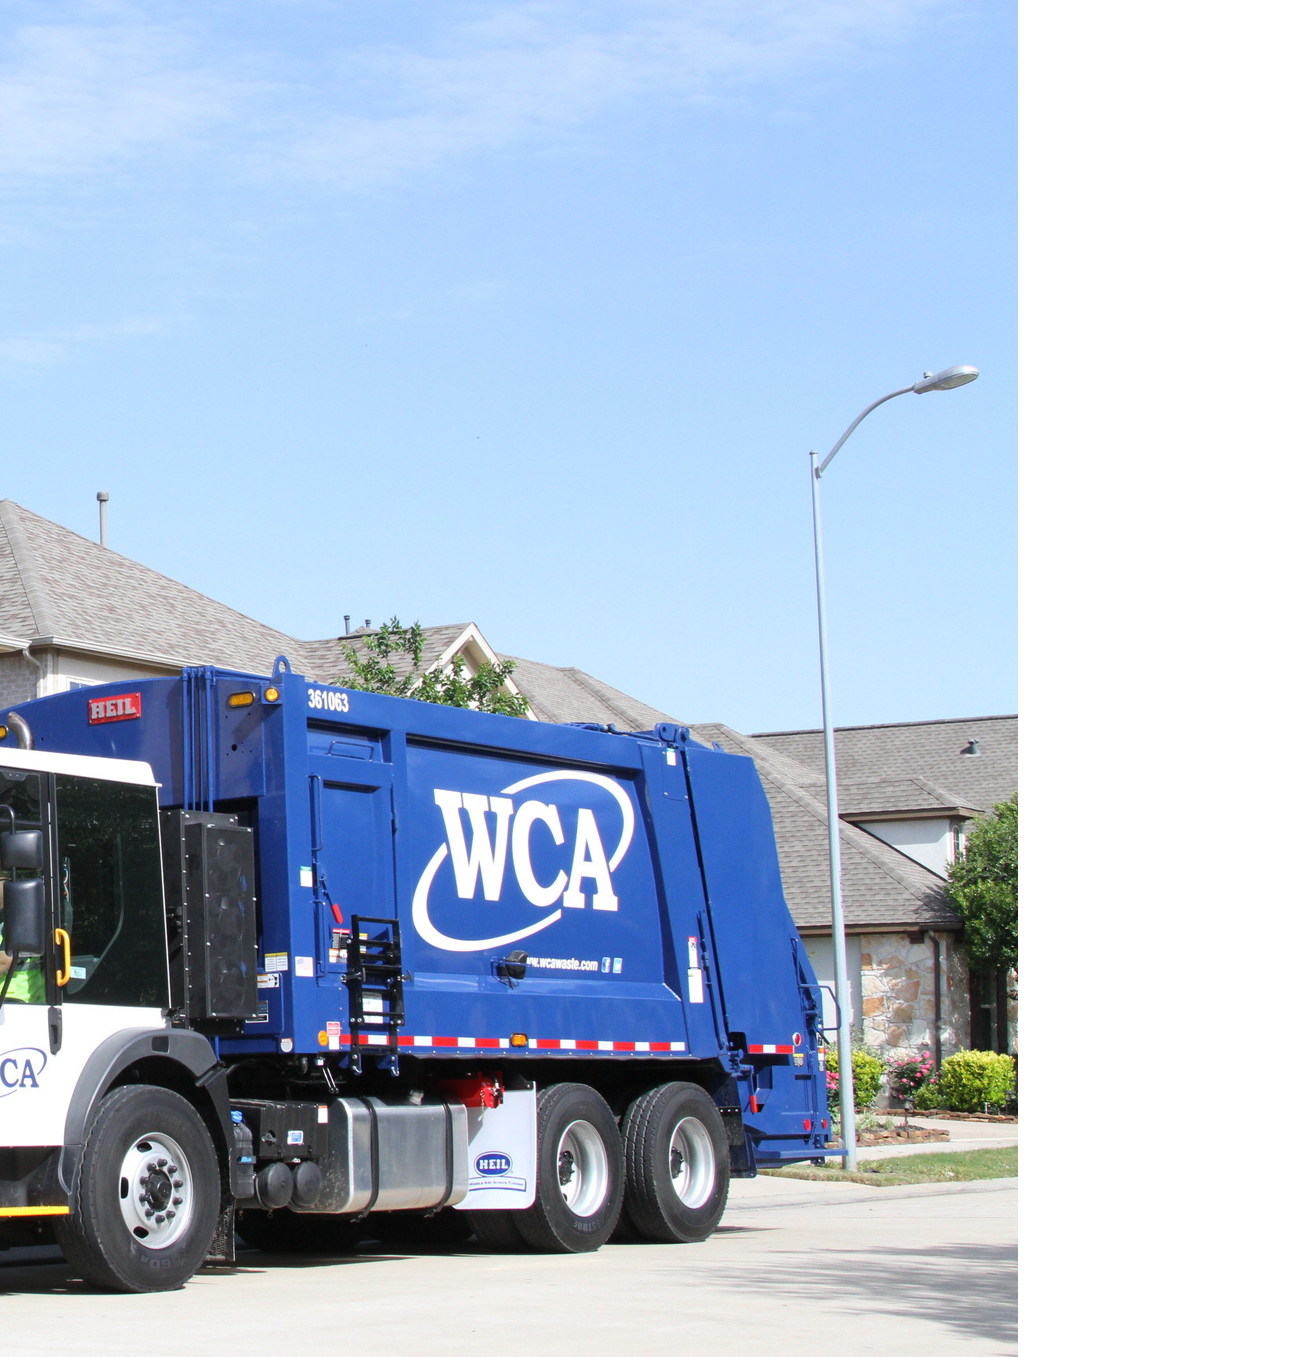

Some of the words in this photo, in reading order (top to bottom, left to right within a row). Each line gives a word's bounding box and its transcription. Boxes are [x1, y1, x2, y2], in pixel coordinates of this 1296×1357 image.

[91, 698, 137, 719] HEIL
[307, 688, 349, 713] 361063
[433, 788, 619, 912] WCA
[526, 957, 598, 971] ww.wcawaste.com
[479, 1159, 508, 1170] HEIL
